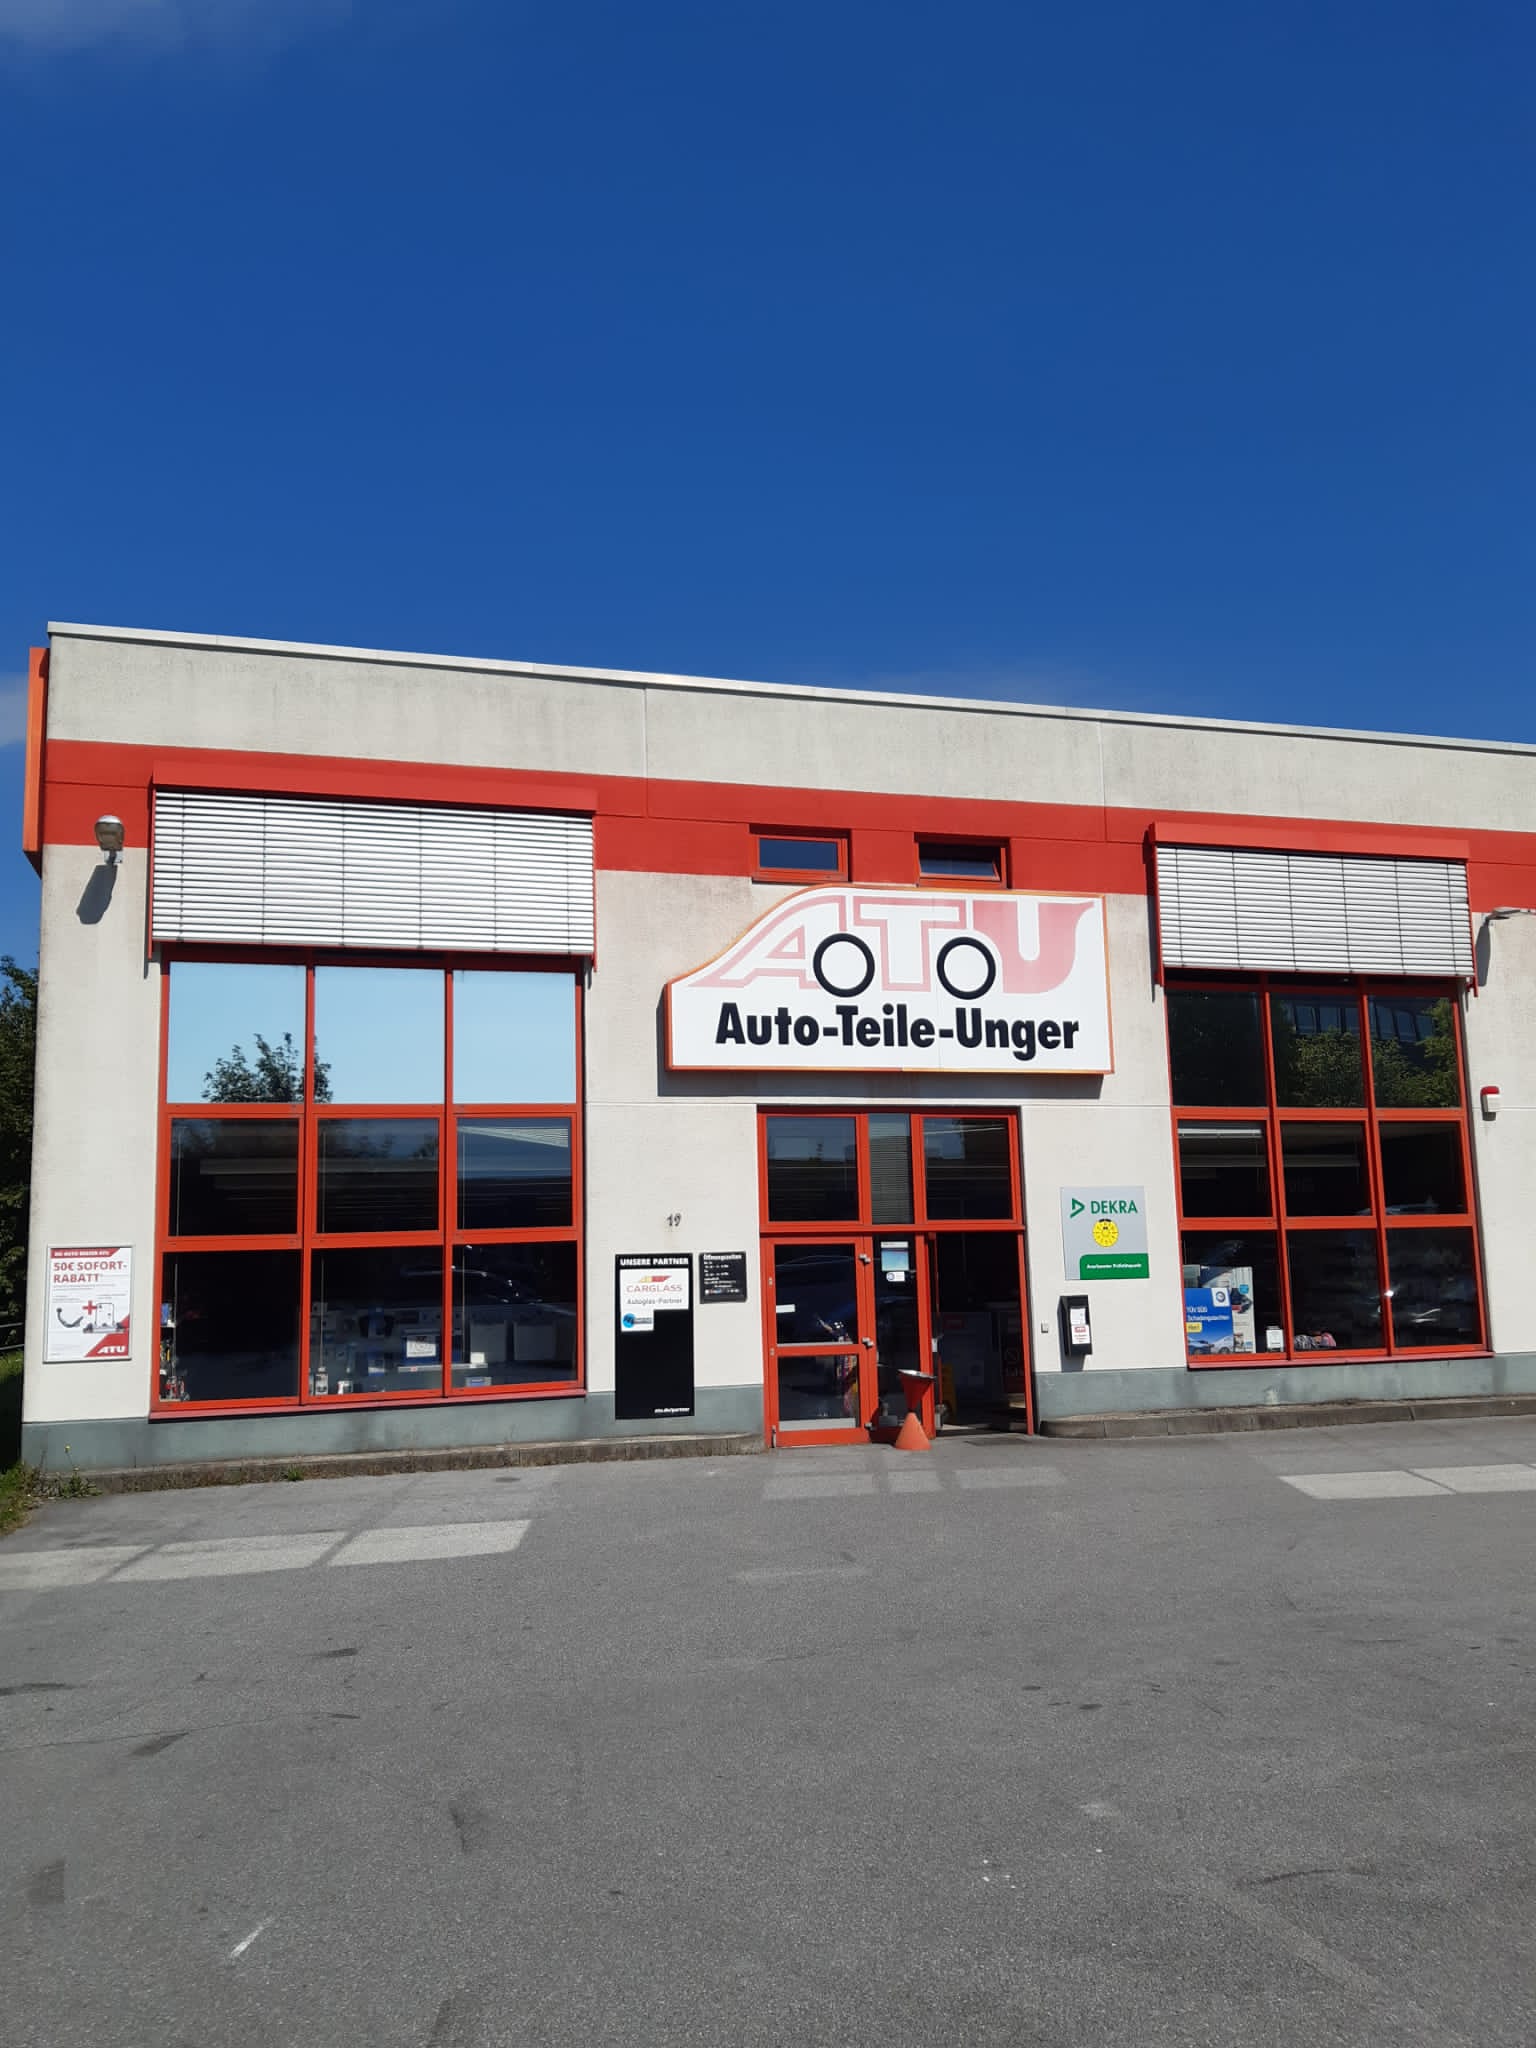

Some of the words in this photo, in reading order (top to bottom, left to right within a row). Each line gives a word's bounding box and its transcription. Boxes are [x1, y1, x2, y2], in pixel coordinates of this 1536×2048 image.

[715, 1001, 1080, 1062] Auto-Teile-Unger
[1090, 1199, 1138, 1214] DEKRA
[53, 1262, 75, 1271] 50€
[77, 1260, 127, 1271] SOFORT-
[619, 1258, 651, 1266] UNSERE
[652, 1257, 689, 1265] PARTNER
[626, 1284, 683, 1293] CARGLASS
[97, 1345, 126, 1354] ATU
